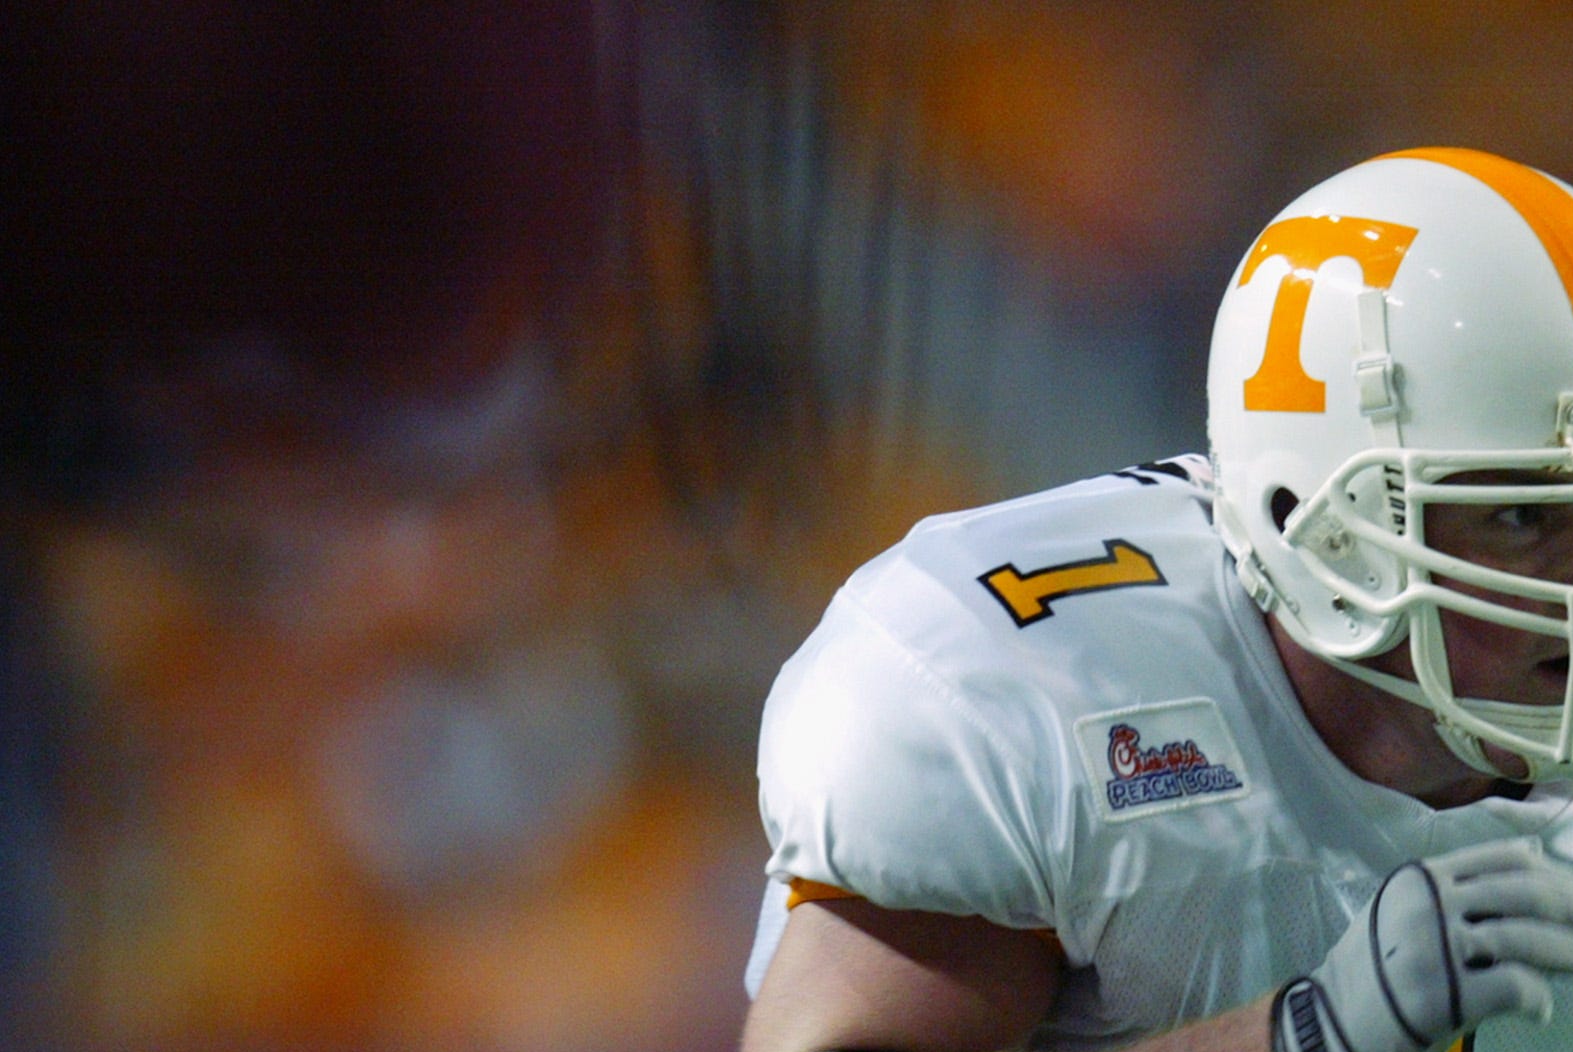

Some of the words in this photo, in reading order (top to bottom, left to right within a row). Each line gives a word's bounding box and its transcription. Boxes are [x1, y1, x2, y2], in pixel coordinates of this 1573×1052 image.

[1237, 215, 1419, 413] T
[1383, 464, 1406, 536] HUTT
[976, 538, 1168, 628] 1
[1108, 773, 1181, 811] PEACH
[1182, 764, 1240, 796] BOWL
